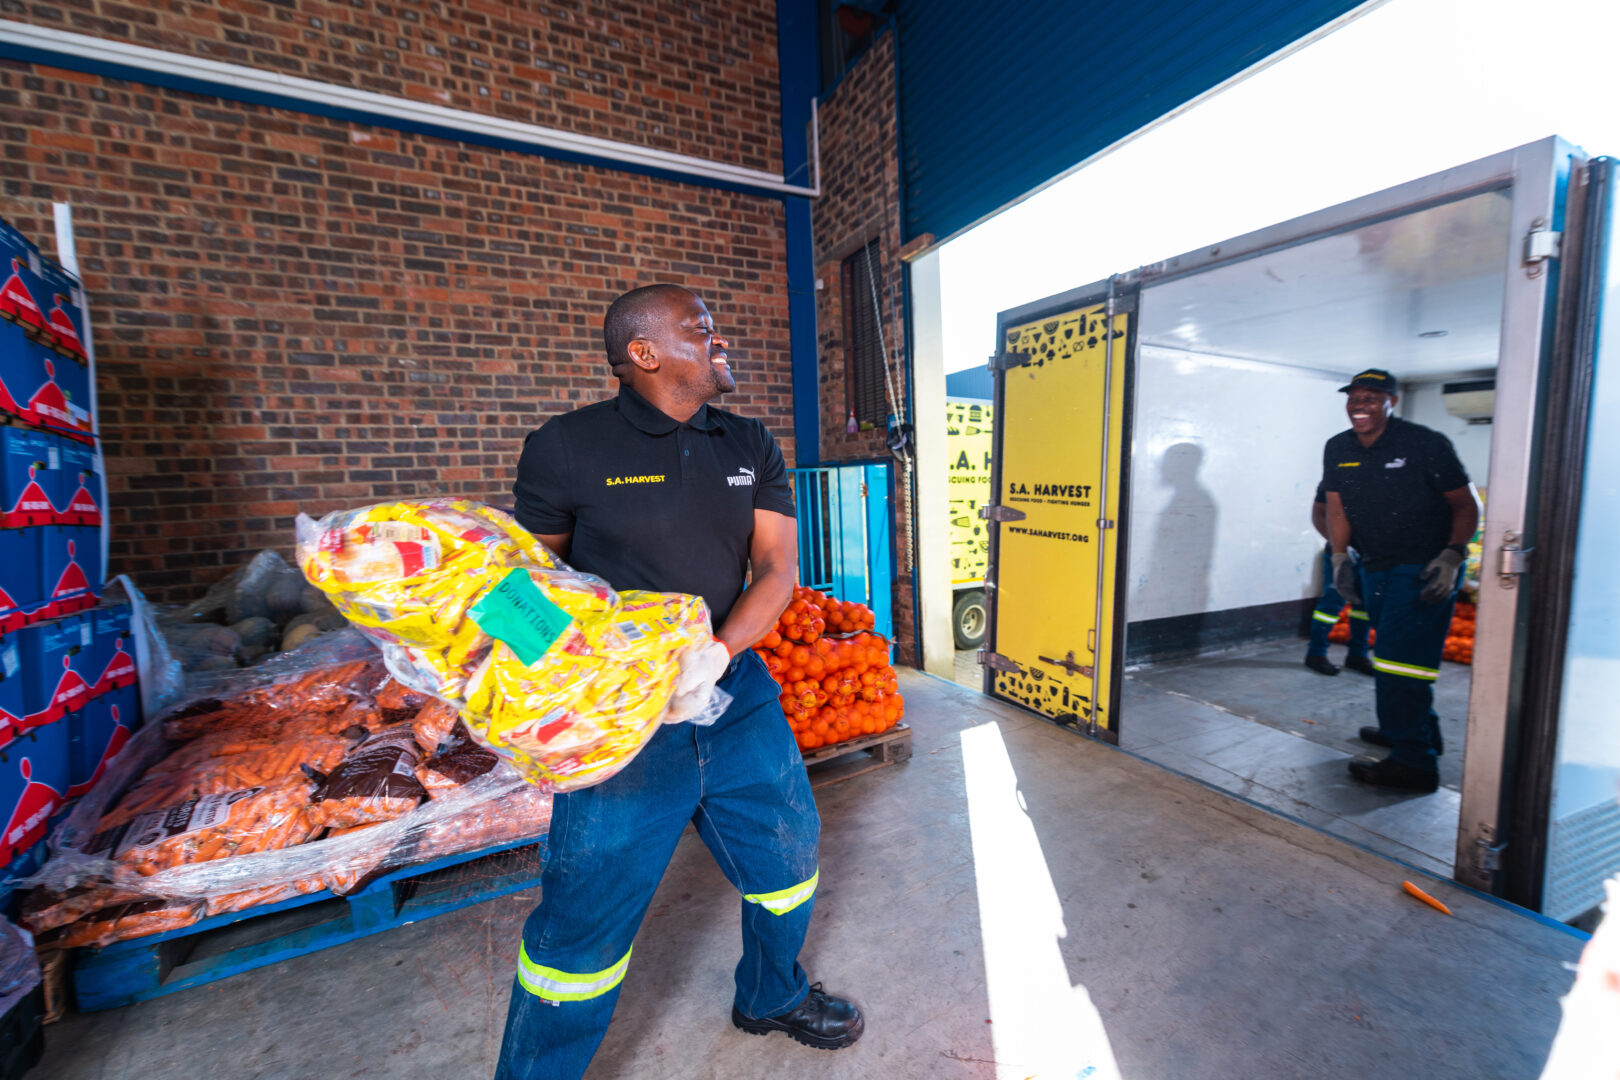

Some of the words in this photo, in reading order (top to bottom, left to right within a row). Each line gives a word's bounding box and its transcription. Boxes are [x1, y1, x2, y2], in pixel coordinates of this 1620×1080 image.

[950, 450, 976, 471] .A.
[727, 475, 753, 487] PUMA
[1009, 482, 1030, 495] S.A.
[1034, 483, 1092, 499] HARVEST
[1008, 526, 1089, 543] WWW.SAHARVEST.ORG
[498, 581, 556, 644] DONATIONS
